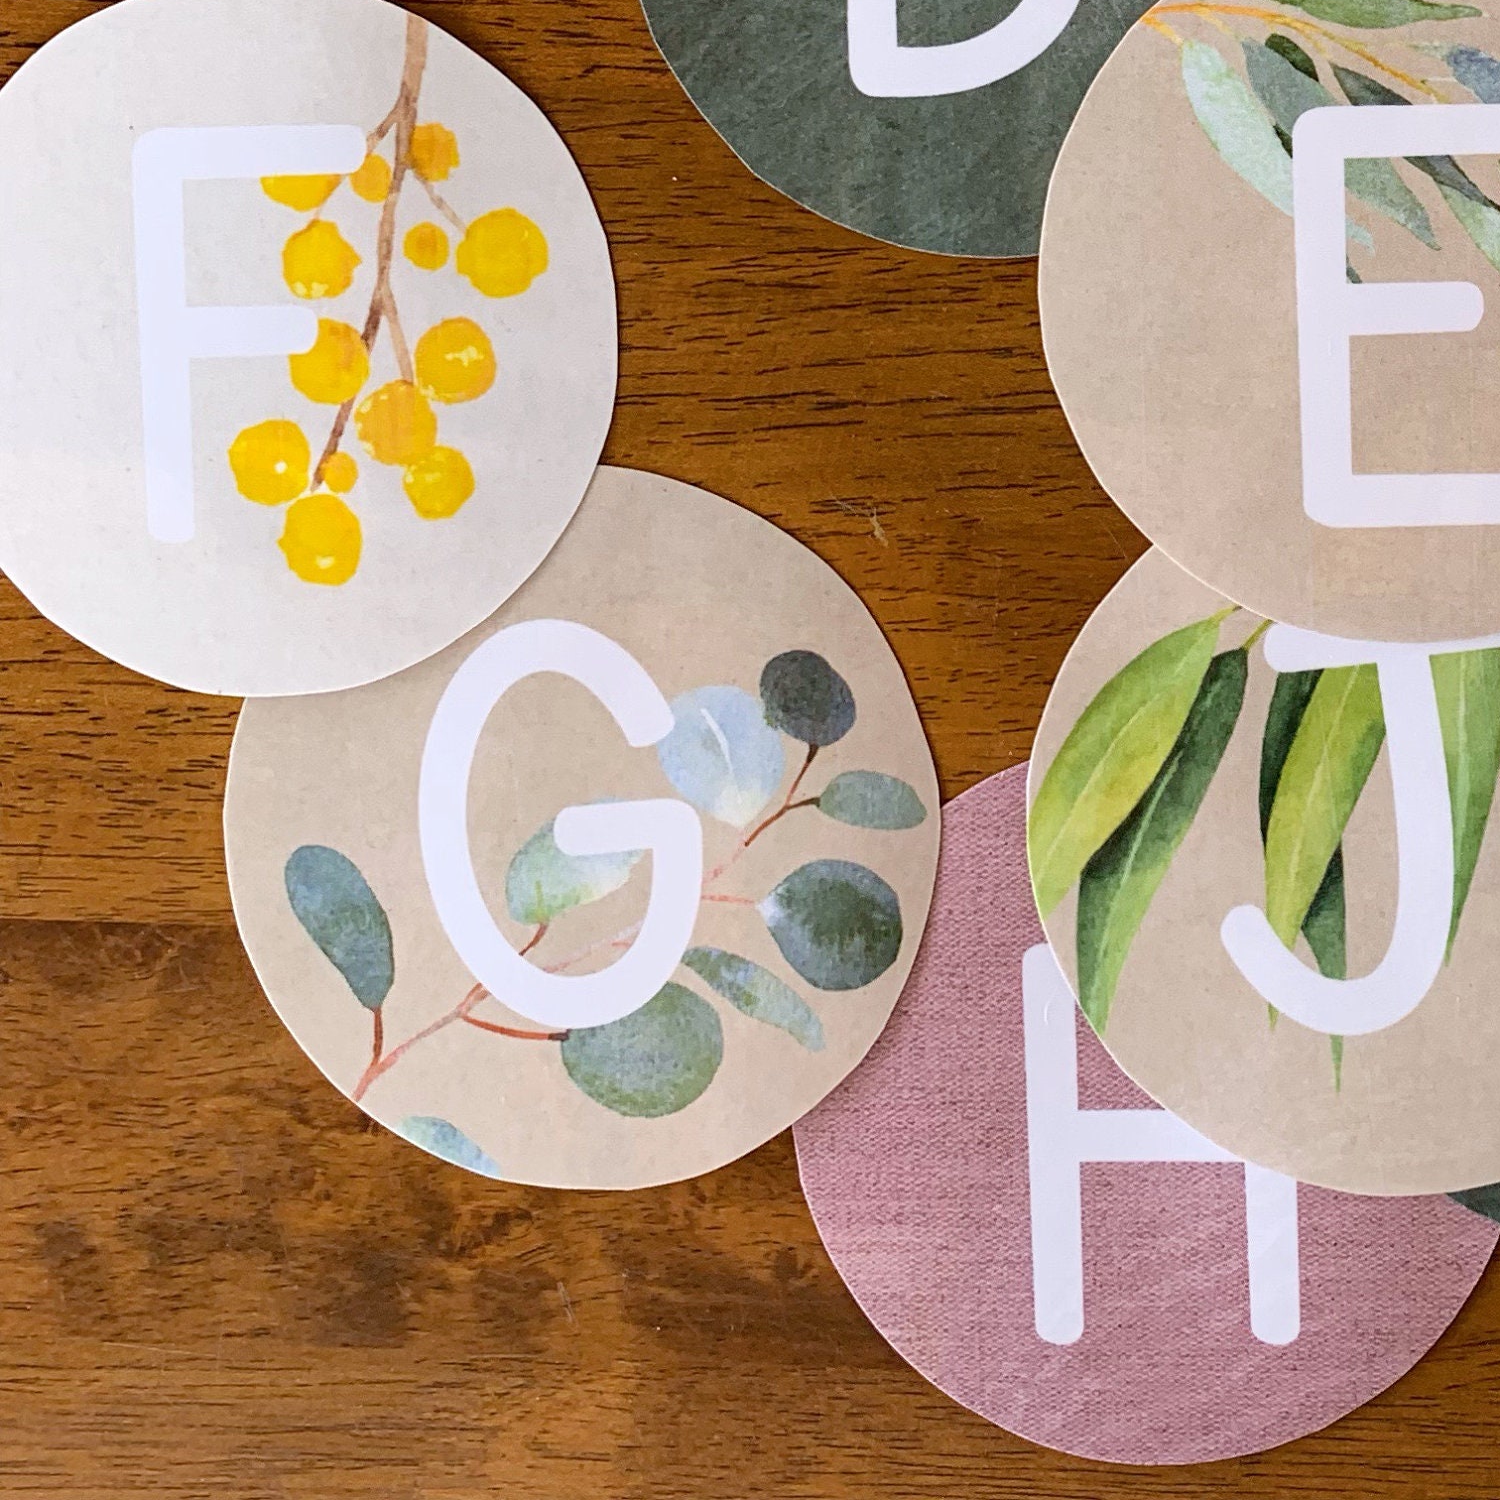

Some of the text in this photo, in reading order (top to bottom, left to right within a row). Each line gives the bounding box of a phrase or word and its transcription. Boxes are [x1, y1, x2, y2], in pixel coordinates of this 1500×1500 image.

[131, 124, 366, 544] F
[417, 617, 703, 1030] G
[1022, 943, 1301, 1347] H
